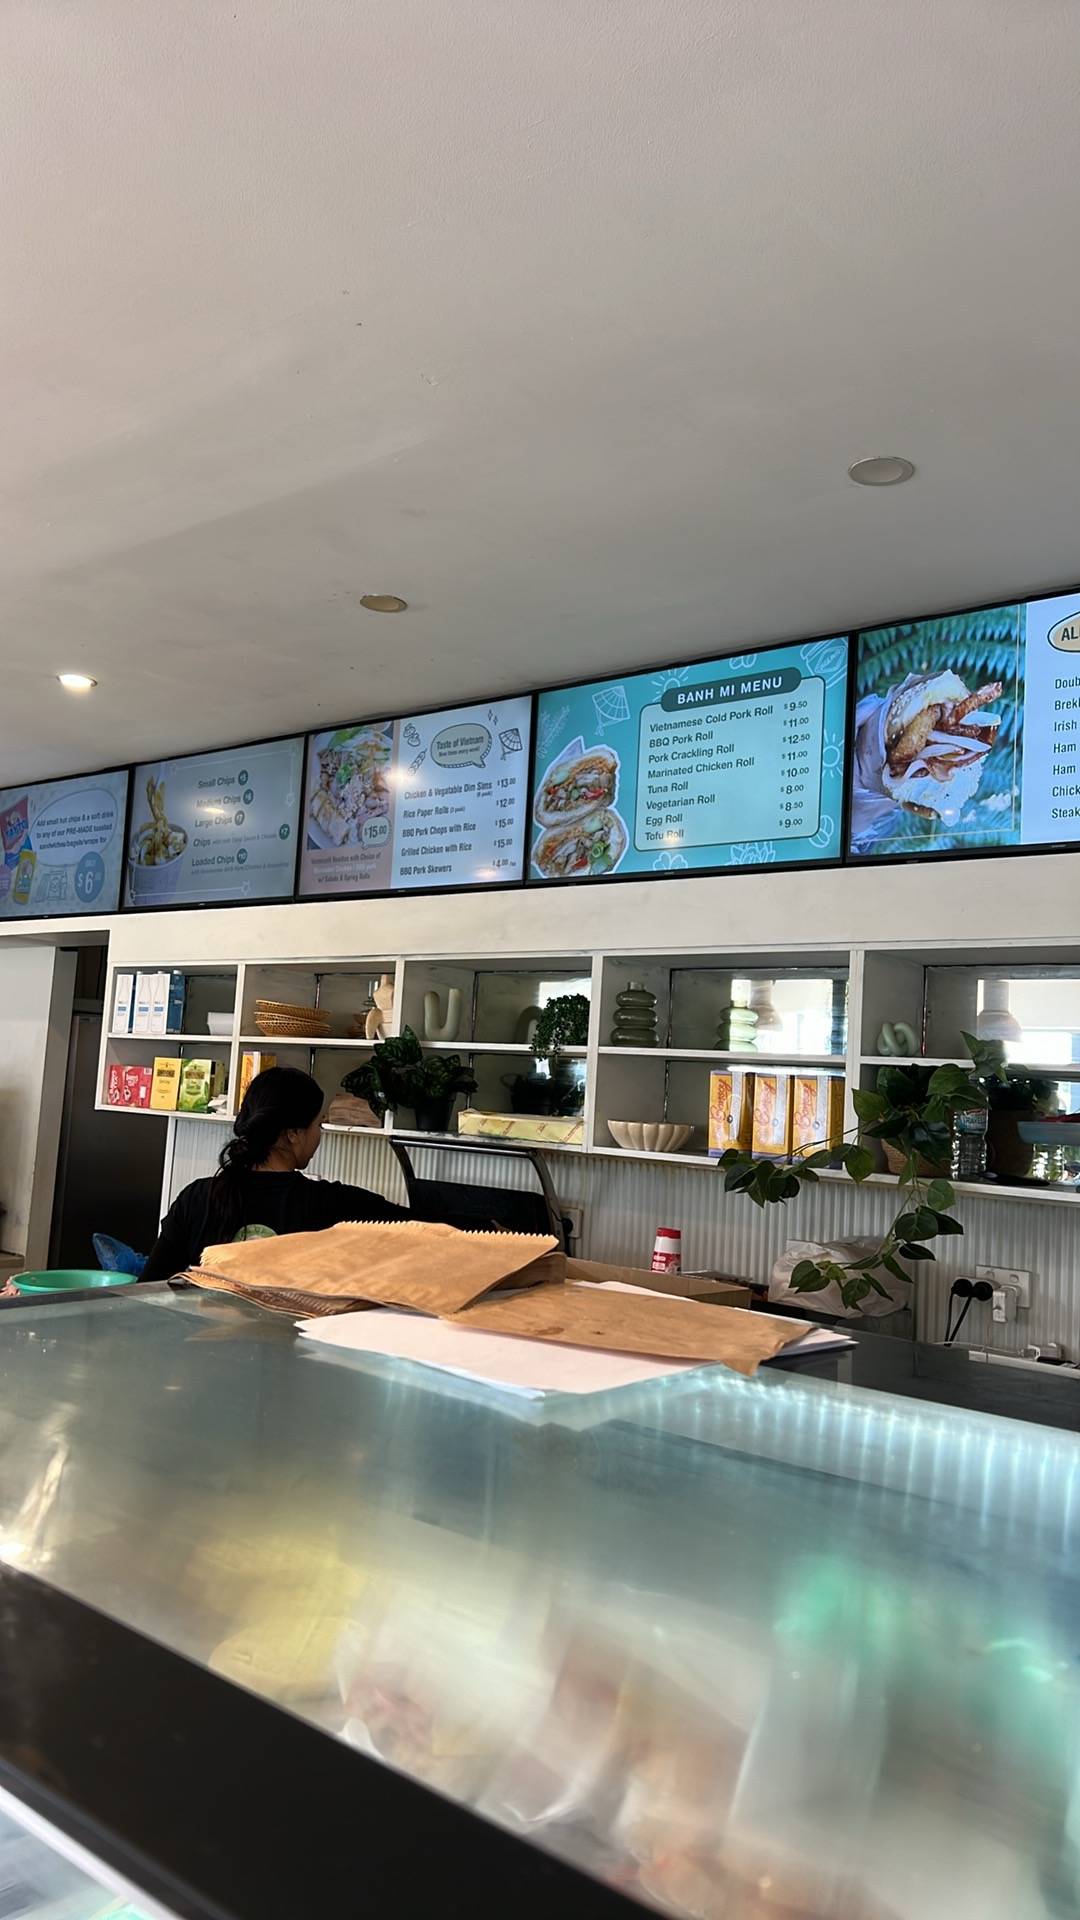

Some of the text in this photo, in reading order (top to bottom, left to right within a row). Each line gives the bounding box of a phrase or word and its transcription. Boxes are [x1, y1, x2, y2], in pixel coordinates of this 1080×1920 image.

[677, 676, 783, 705] BANH MI MENU
[649, 718, 703, 733] Vietnamese
[705, 713, 727, 724] Cold
[729, 709, 752, 721] Pork
[754, 705, 774, 717] Roll
[1054, 719, 1077, 732] Irish
[436, 736, 484, 750] Taste of Vietnam
[649, 737, 670, 748] BBQ
[672, 734, 693, 745] Pork
[695, 731, 714, 742] Roll
[648, 753, 669, 764] Pork
[671, 747, 714, 760] Crackling
[716, 744, 735, 755] Roll
[1053, 742, 1076, 754] Ham
[647, 766, 693, 779] Marinated
[696, 760, 733, 772] Chicken
[736, 757, 755, 768] Roll
[1052, 764, 1076, 776] Ham
[217, 776, 235, 786] Chips
[647, 784, 668, 794] Tuna
[671, 781, 689, 792] Roll
[404, 790, 427, 800] Chicken
[428, 789, 433, 797] &
[464, 783, 476, 793] Dim
[476, 782, 492, 791] Sims
[222, 795, 241, 805] Chips
[646, 797, 695, 811] Vegetarian
[697, 794, 715, 805] Roll
[403, 809, 416, 818] Rice
[416, 808, 434, 818] Paper
[434, 806, 449, 815] Rolls
[645, 816, 663, 827] Egg
[665, 813, 683, 824] Roll
[402, 829, 415, 838] BBQ
[415, 827, 428, 836] Pork
[429, 826, 448, 836] Chops
[448, 824, 462, 832] with
[462, 823, 476, 831] Rice
[645, 831, 664, 841] Tofu
[666, 829, 684, 840] Roll
[193, 838, 211, 848] Chips
[401, 847, 420, 857] Grilled
[421, 846, 444, 855] Chicken
[445, 844, 458, 853] with
[459, 842, 472, 851] Rice
[191, 856, 216, 867] Loaded
[216, 855, 235, 866] Chips
[400, 866, 412, 875] BBQ
[412, 866, 426, 875] Pork
[427, 864, 452, 874] Skewers
